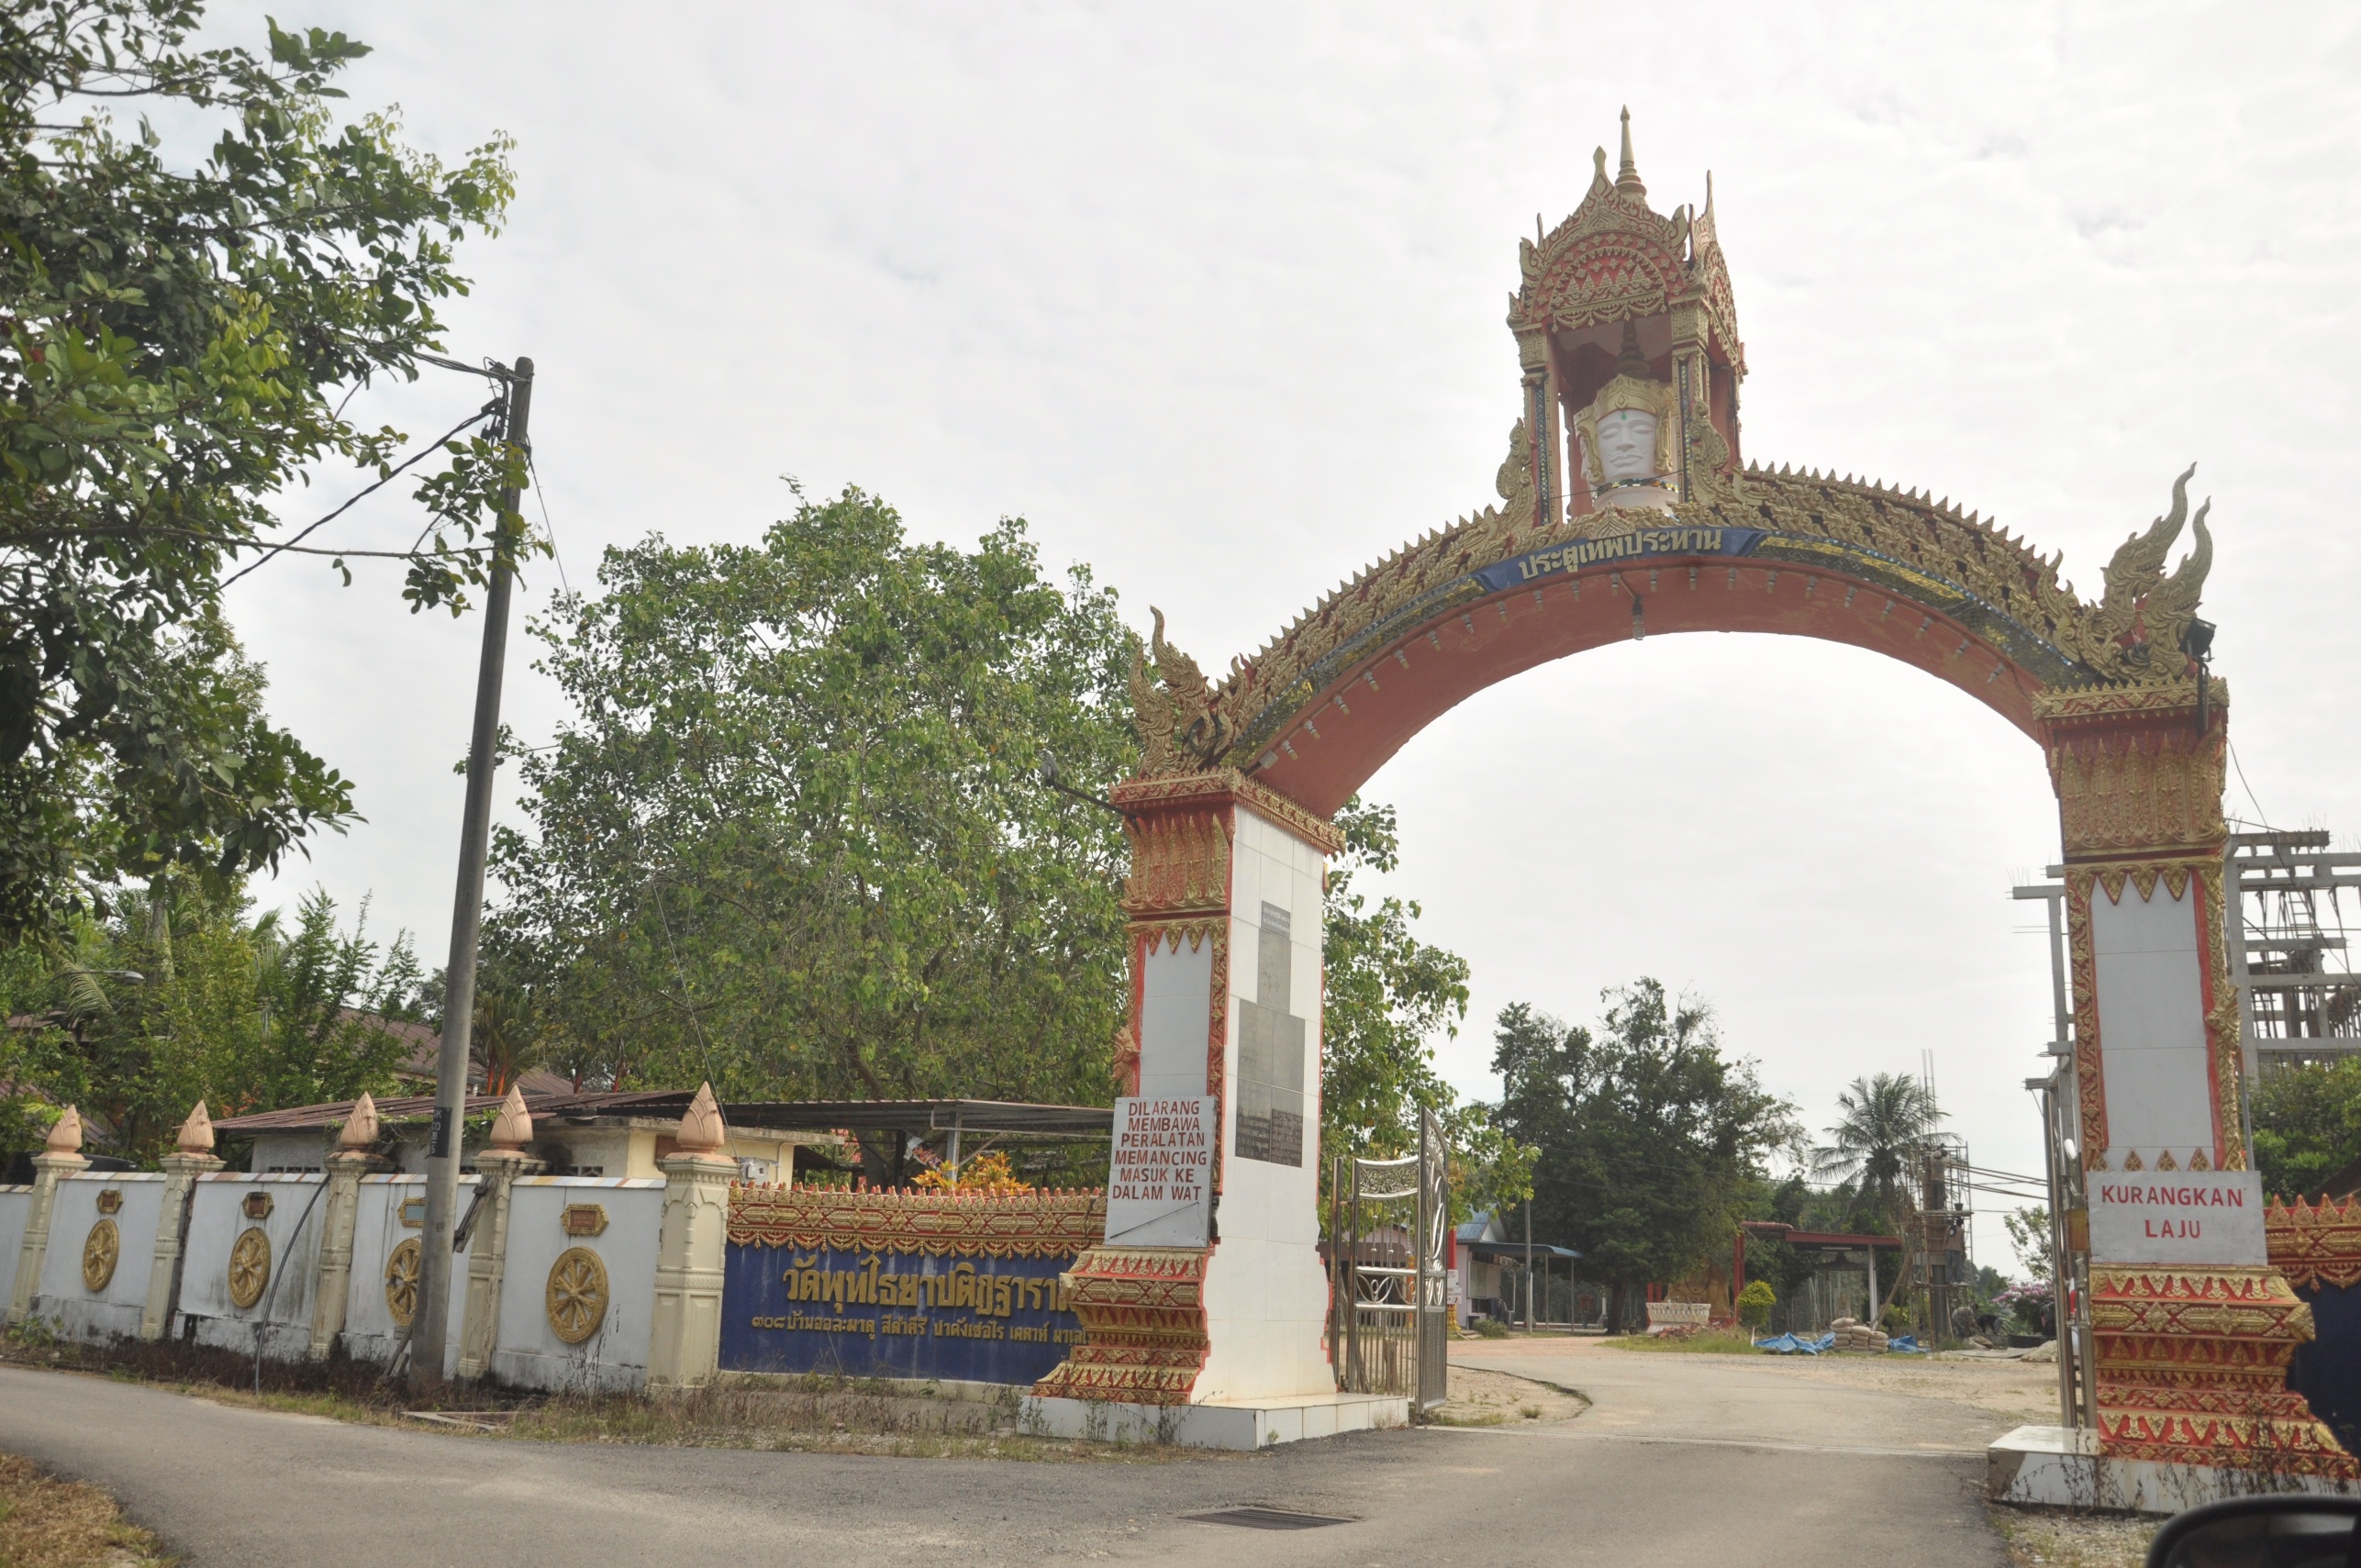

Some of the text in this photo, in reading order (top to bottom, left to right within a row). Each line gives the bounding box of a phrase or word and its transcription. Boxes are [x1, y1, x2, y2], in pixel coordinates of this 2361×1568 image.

[1518, 528, 1721, 580] ประตูเทพประทาน
[1128, 1101, 1200, 1118] DILARANG
[1128, 1118, 1200, 1132] MEMBAWA
[1121, 1132, 1205, 1147] PERALATAN
[1114, 1150, 1208, 1166] MEMANCING
[1119, 1168, 1195, 1183] MASUK KE
[1112, 1185, 1202, 1201] DALAM WAT
[2101, 1184, 2243, 1207] KURANGKAN
[2144, 1219, 2201, 1239] LAJU
[783, 1253, 1075, 1318] วัดพุทไธยาปติฏฐารา
